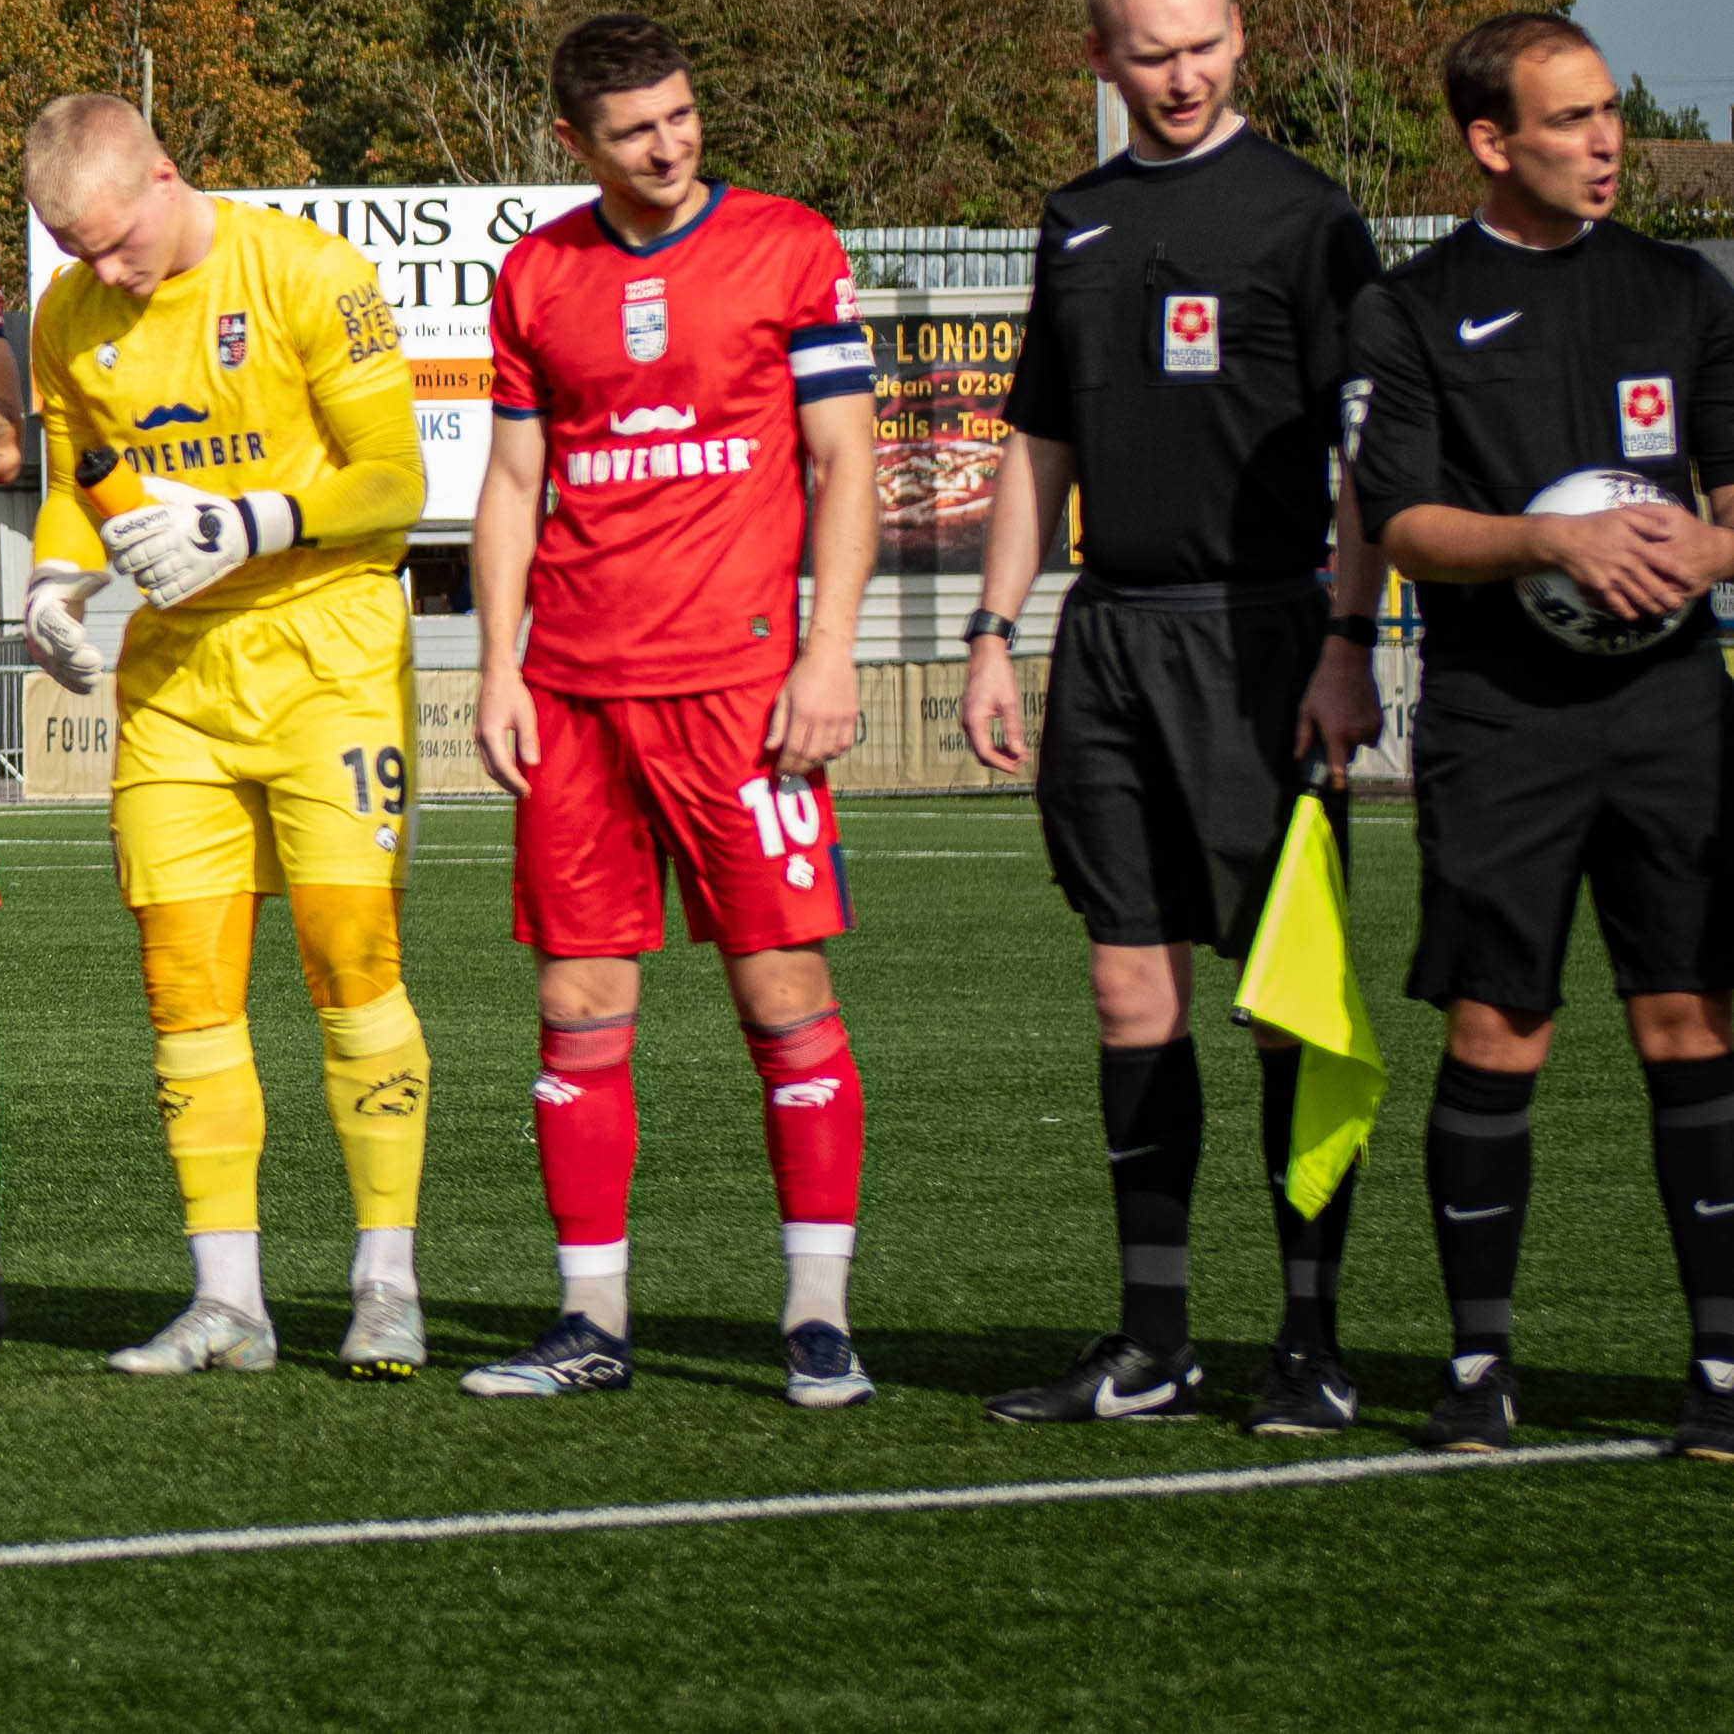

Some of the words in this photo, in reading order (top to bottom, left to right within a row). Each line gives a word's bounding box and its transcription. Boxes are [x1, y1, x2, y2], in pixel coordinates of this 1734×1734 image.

[487, 197, 536, 245] &
[336, 282, 379, 318] QUA
[346, 301, 390, 340] RTE
[415, 322, 441, 337] the
[349, 326, 401, 363] BAC
[896, 320, 1026, 364] LONDO
[415, 362, 490, 391] mins-p
[875, 374, 932, 398] dean
[873, 412, 930, 441] tails
[957, 411, 1015, 443] Tap
[122, 431, 267, 474] OVEMBER
[567, 437, 752, 487] MOVEMBER
[418, 703, 449, 727] PAS
[920, 696, 961, 722] COCK
[1022, 692, 1046, 717] TAP
[46, 716, 108, 753] FOUR
[342, 746, 407, 815] 19
[738, 775, 820, 859] 10
